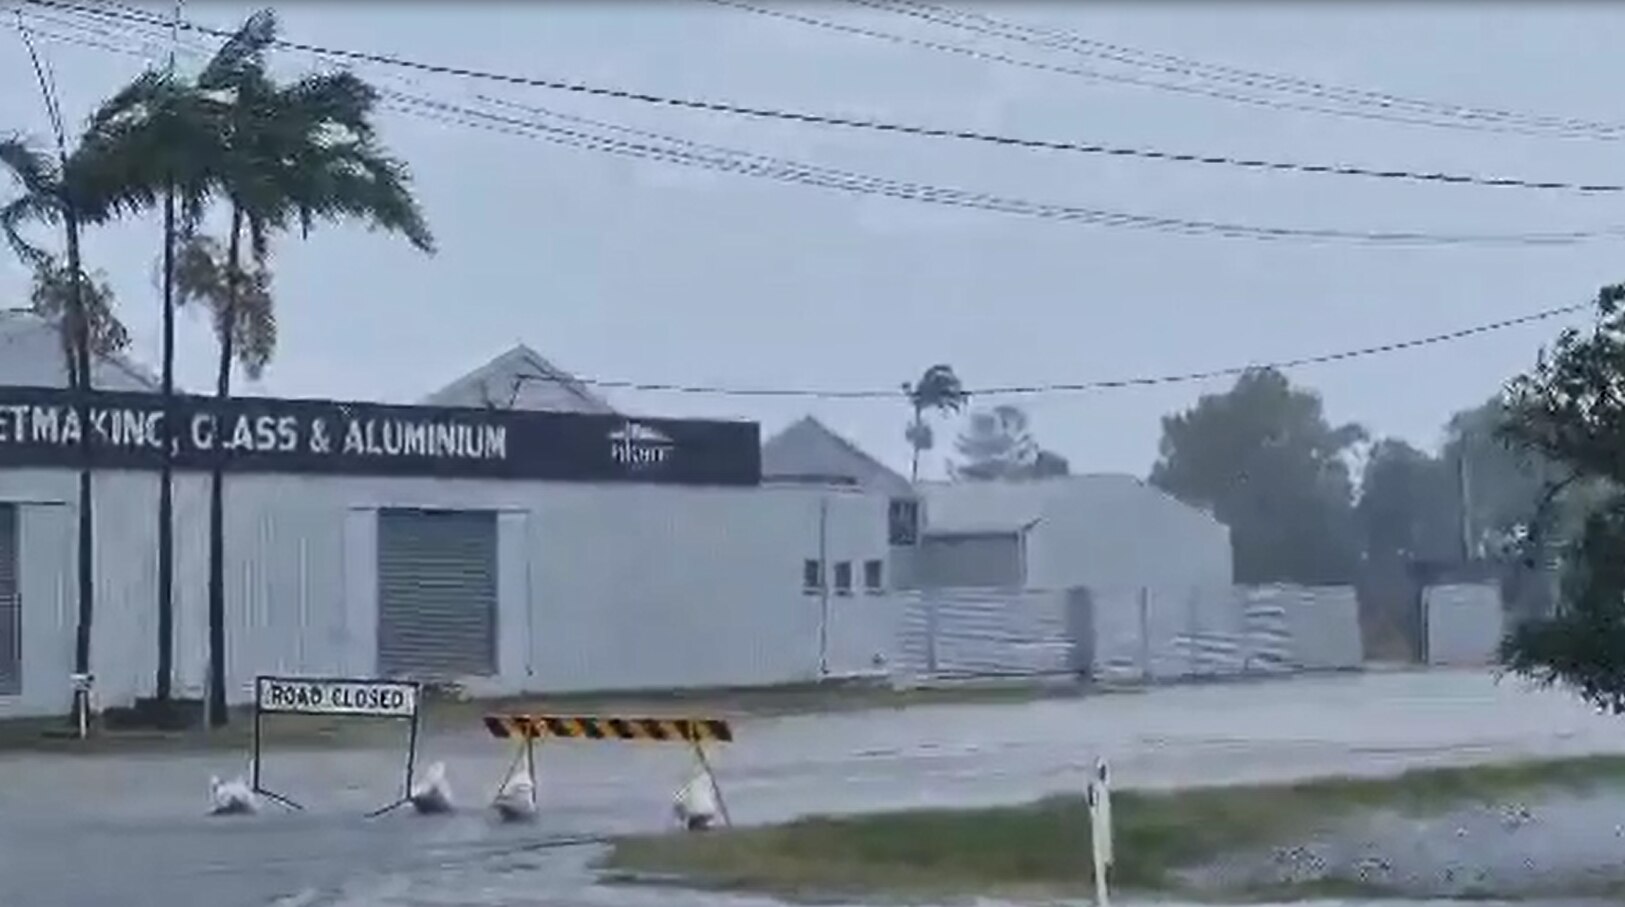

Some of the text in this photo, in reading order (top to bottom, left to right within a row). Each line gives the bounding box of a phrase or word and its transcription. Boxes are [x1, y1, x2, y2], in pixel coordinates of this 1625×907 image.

[309, 418, 330, 453] &
[343, 420, 506, 459] ALUMINIUM
[271, 685, 404, 709] ROAD CLOSED
